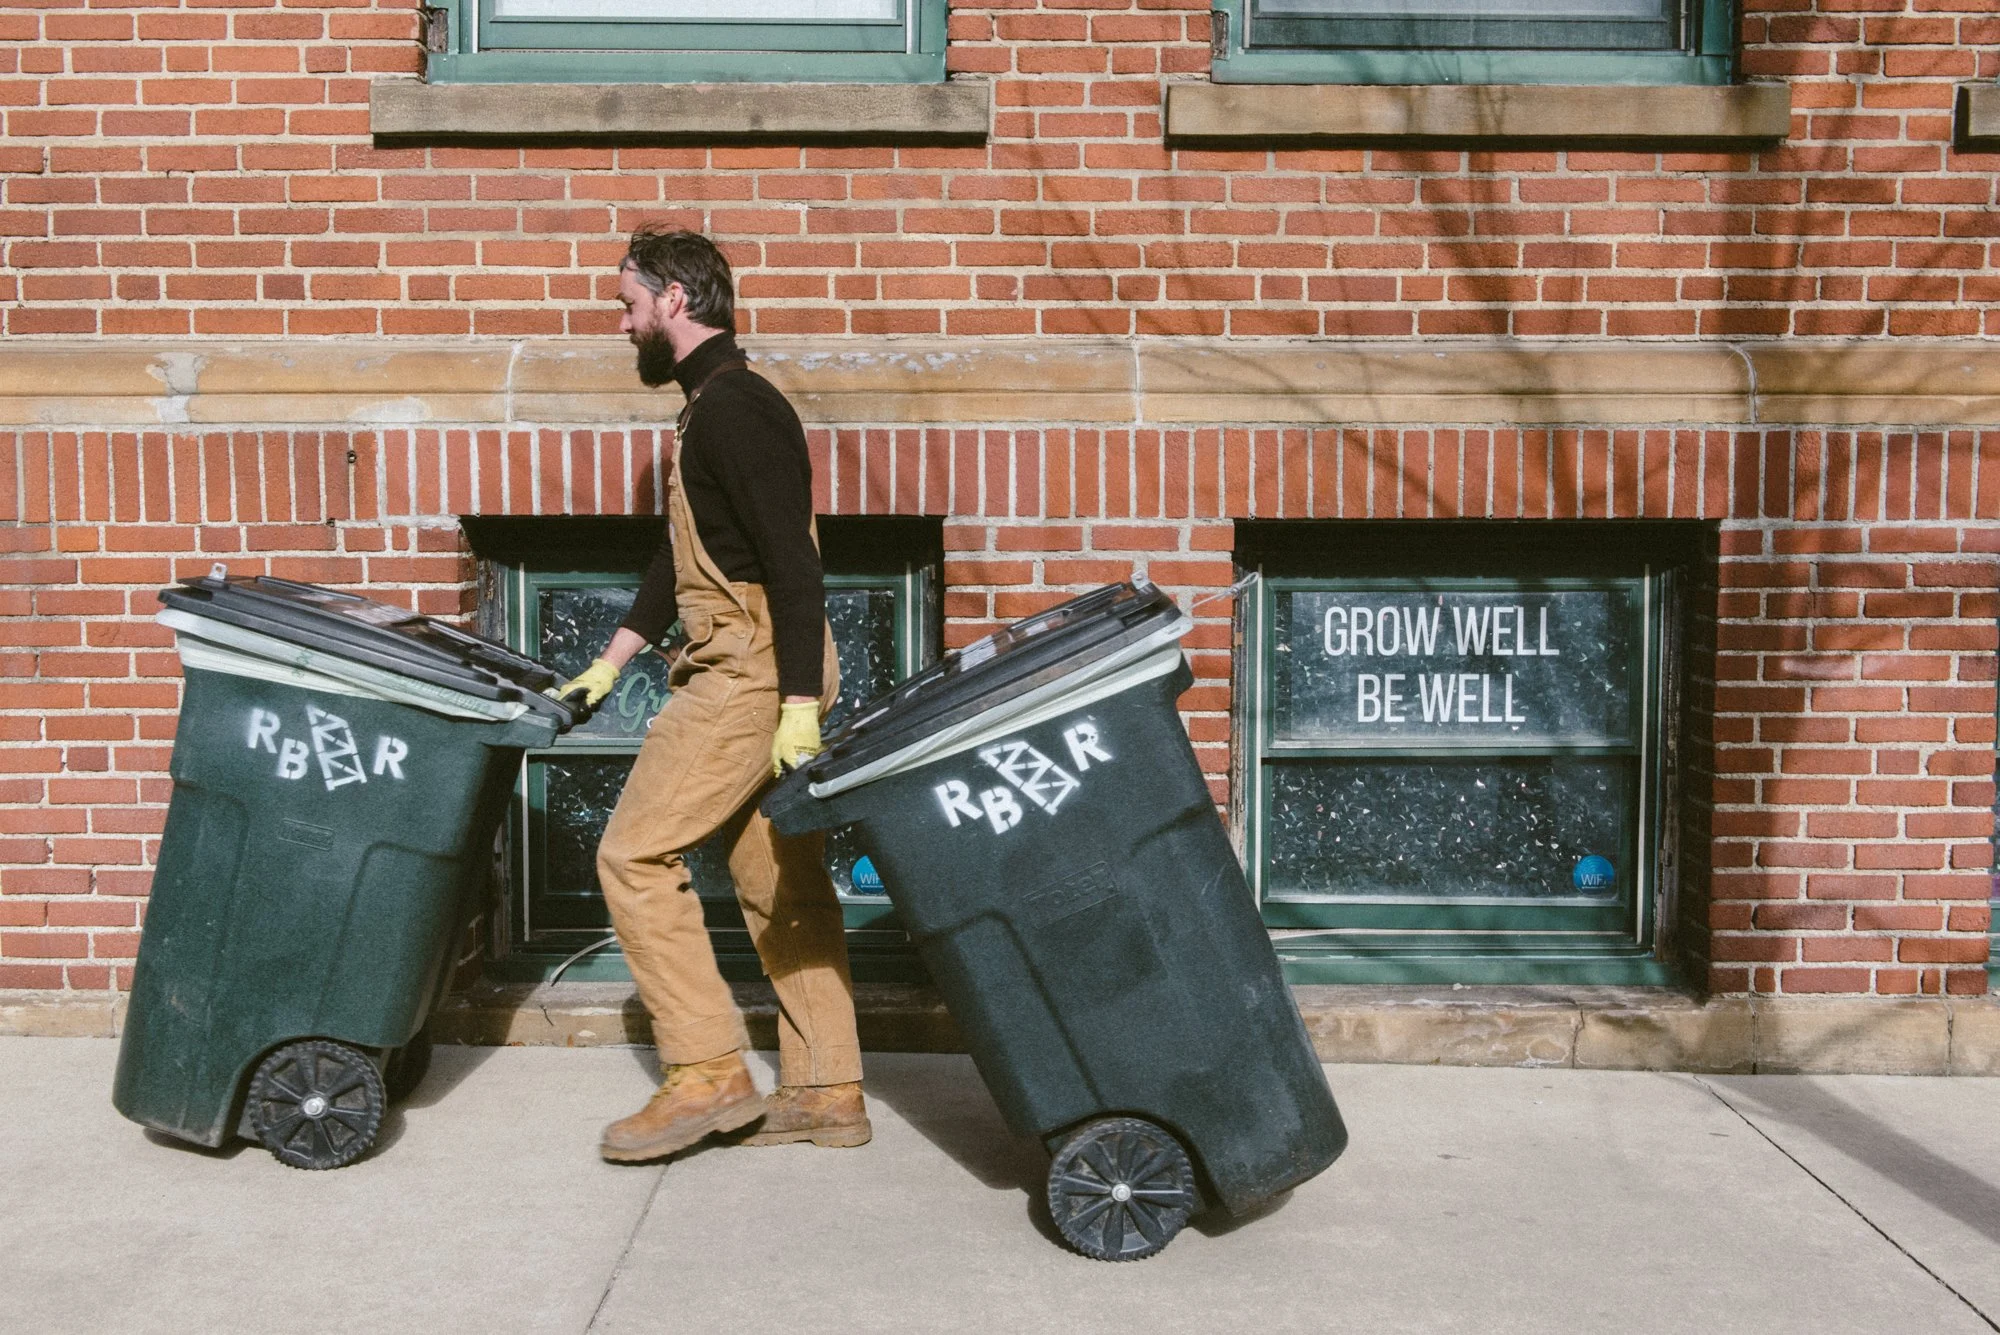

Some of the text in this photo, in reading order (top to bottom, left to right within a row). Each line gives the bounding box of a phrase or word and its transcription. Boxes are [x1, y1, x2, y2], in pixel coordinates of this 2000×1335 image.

[1324, 606, 1560, 656] GROW WELL
[1357, 673, 1526, 723] BE WELL
